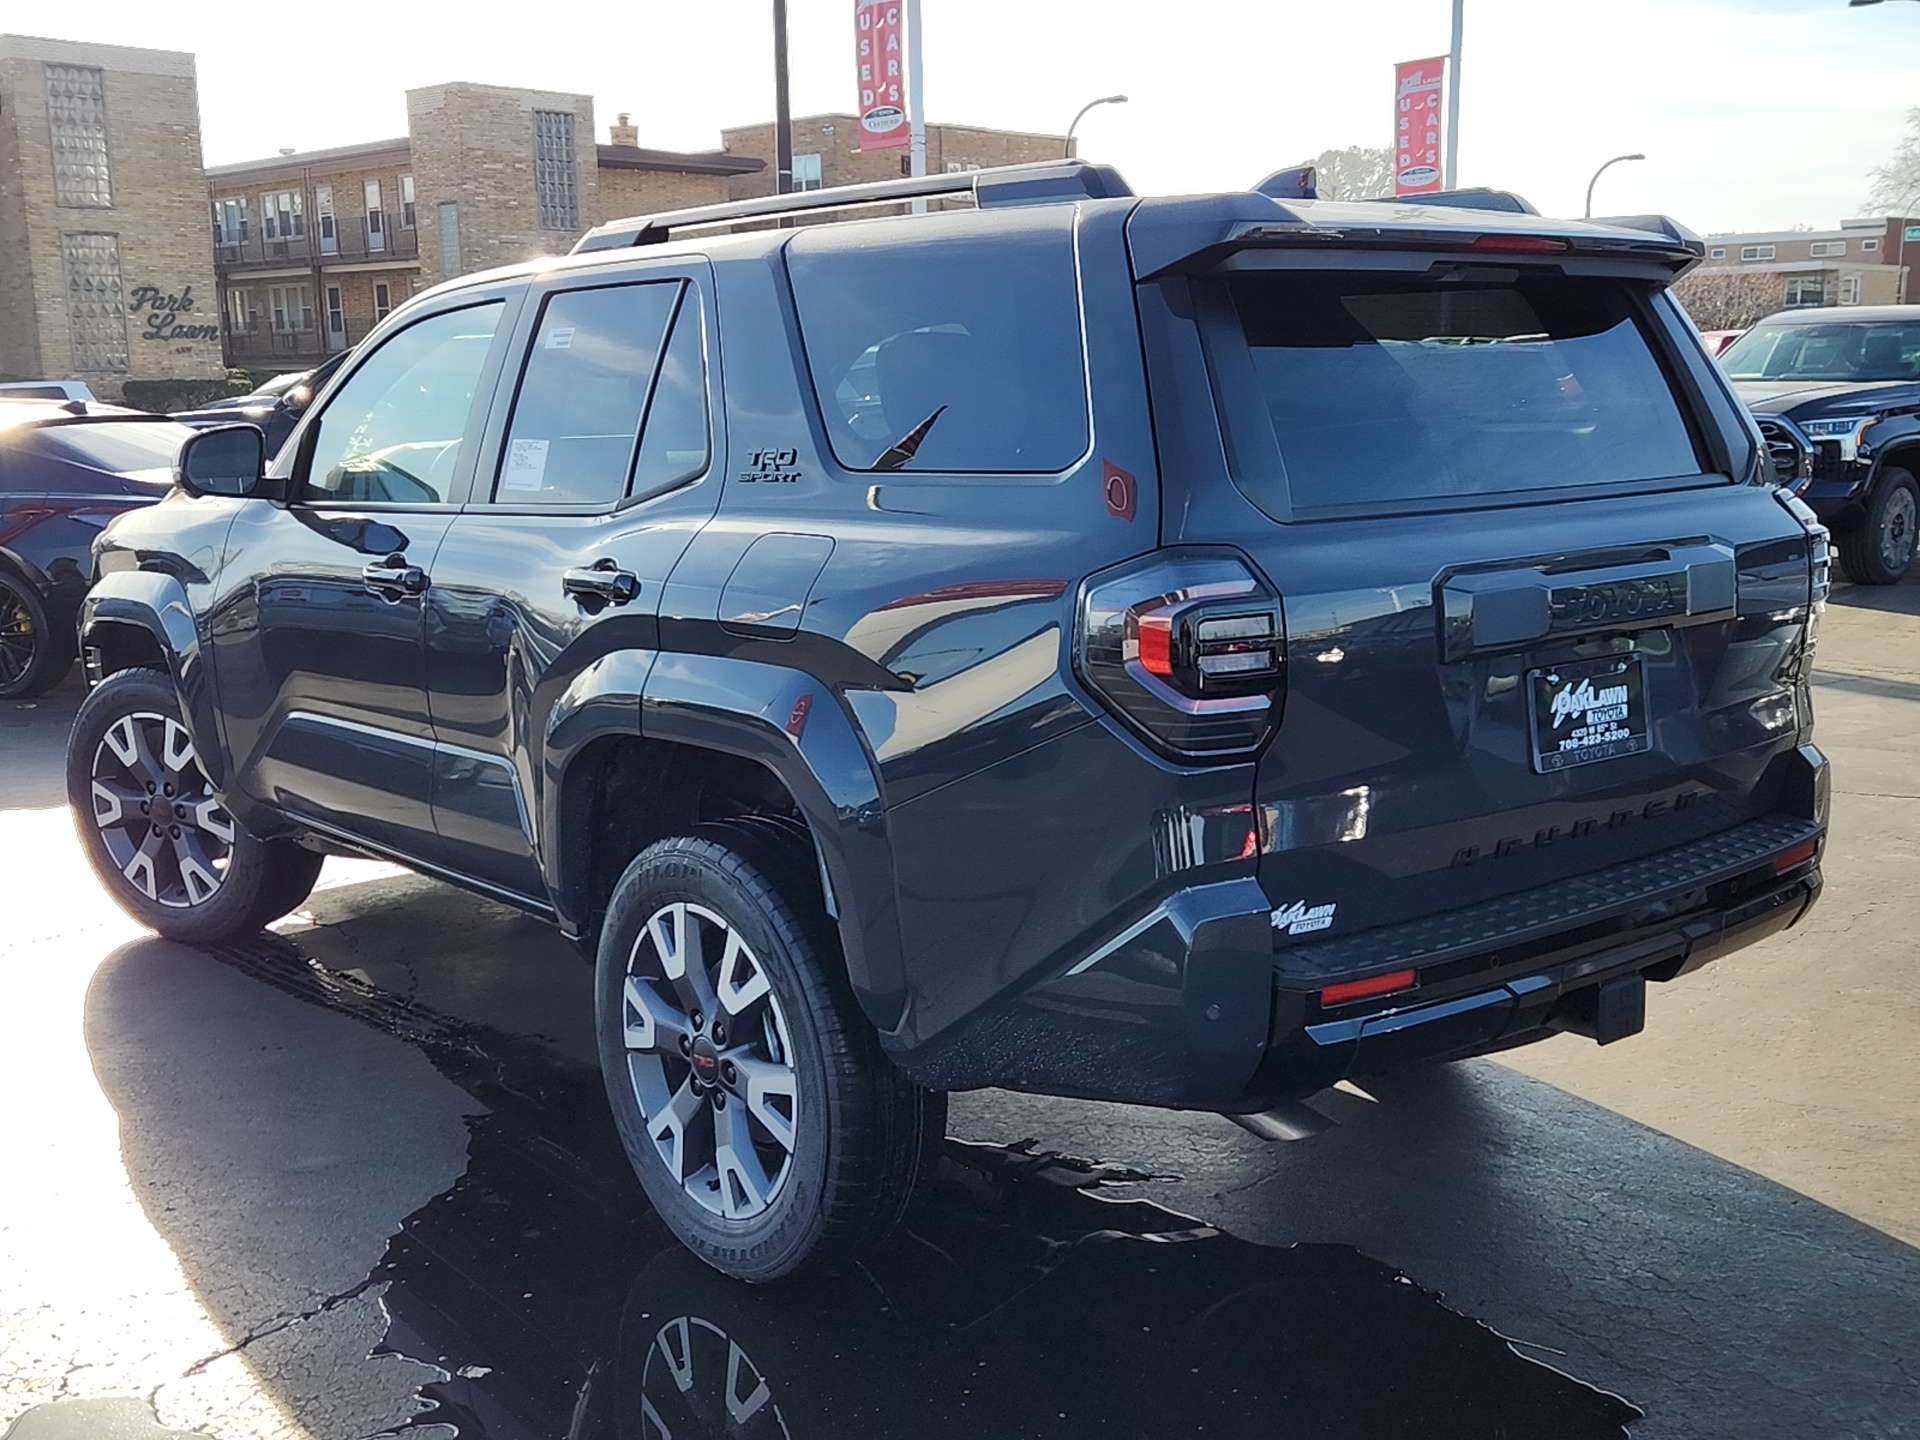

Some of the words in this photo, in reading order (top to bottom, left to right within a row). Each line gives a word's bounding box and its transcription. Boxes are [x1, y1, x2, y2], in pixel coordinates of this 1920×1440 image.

[860, 13, 874, 106] USED
[886, 8, 901, 101] CARS
[1400, 98, 1411, 167] USED
[1425, 93, 1438, 164] CARS
[129, 285, 194, 312] Park
[142, 313, 219, 341] Lawn
[747, 447, 798, 472] TRD
[738, 472, 802, 483] SPORT
[1592, 707, 1624, 722] TOYOTA
[1559, 728, 1630, 751] 708-423-5200
[1573, 743, 1617, 762] TOYOTA
